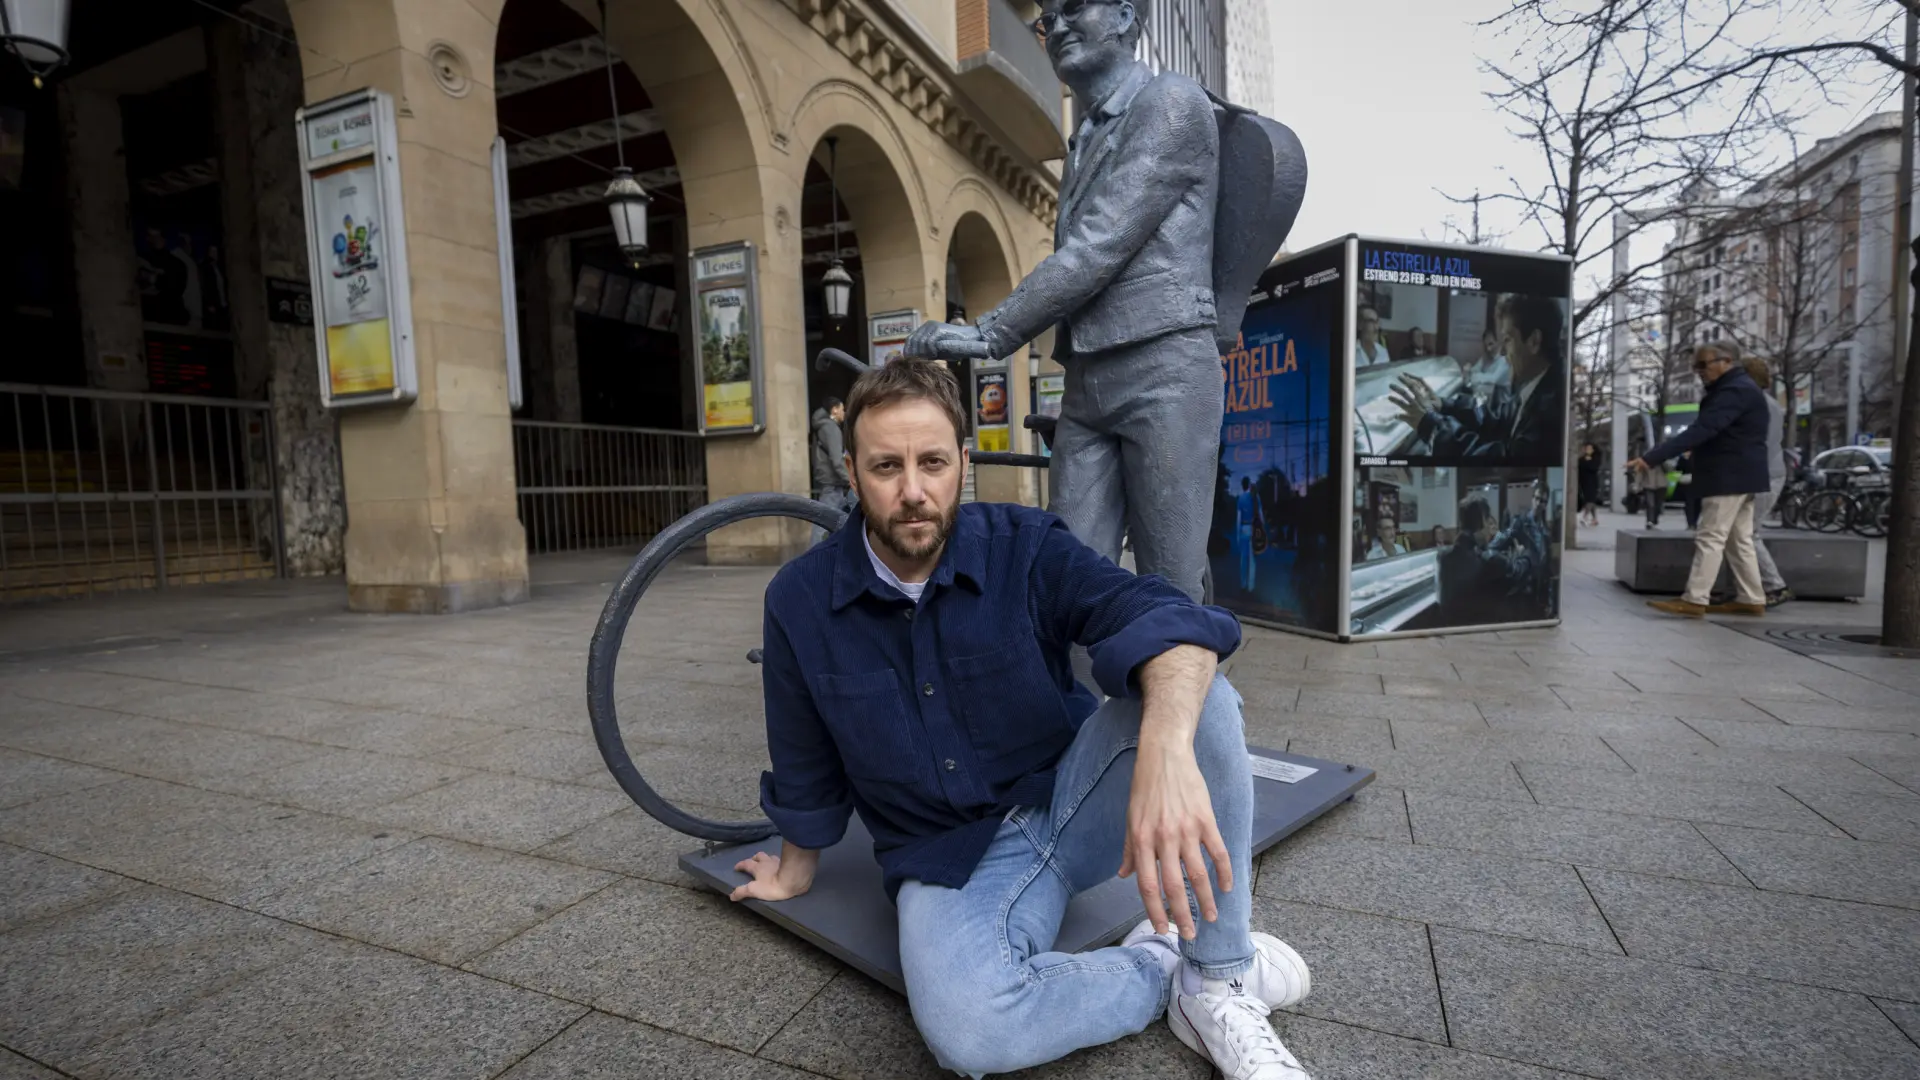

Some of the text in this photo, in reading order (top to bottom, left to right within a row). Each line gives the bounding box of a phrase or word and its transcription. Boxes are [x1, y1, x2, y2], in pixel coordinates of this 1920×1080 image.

[712, 260, 742, 272] CINES
[1364, 249, 1473, 277] LA ESTRELLA AZUL
[1363, 268, 1399, 282] ESTRENO
[1399, 271, 1410, 283] 23
[1410, 272, 1425, 285] FEB
[1430, 274, 1449, 287] SOLO
[1449, 275, 1460, 288] EN
[1460, 276, 1482, 290] CINES
[1219, 338, 1298, 383] STRELLA
[1225, 376, 1273, 414] AZUL
